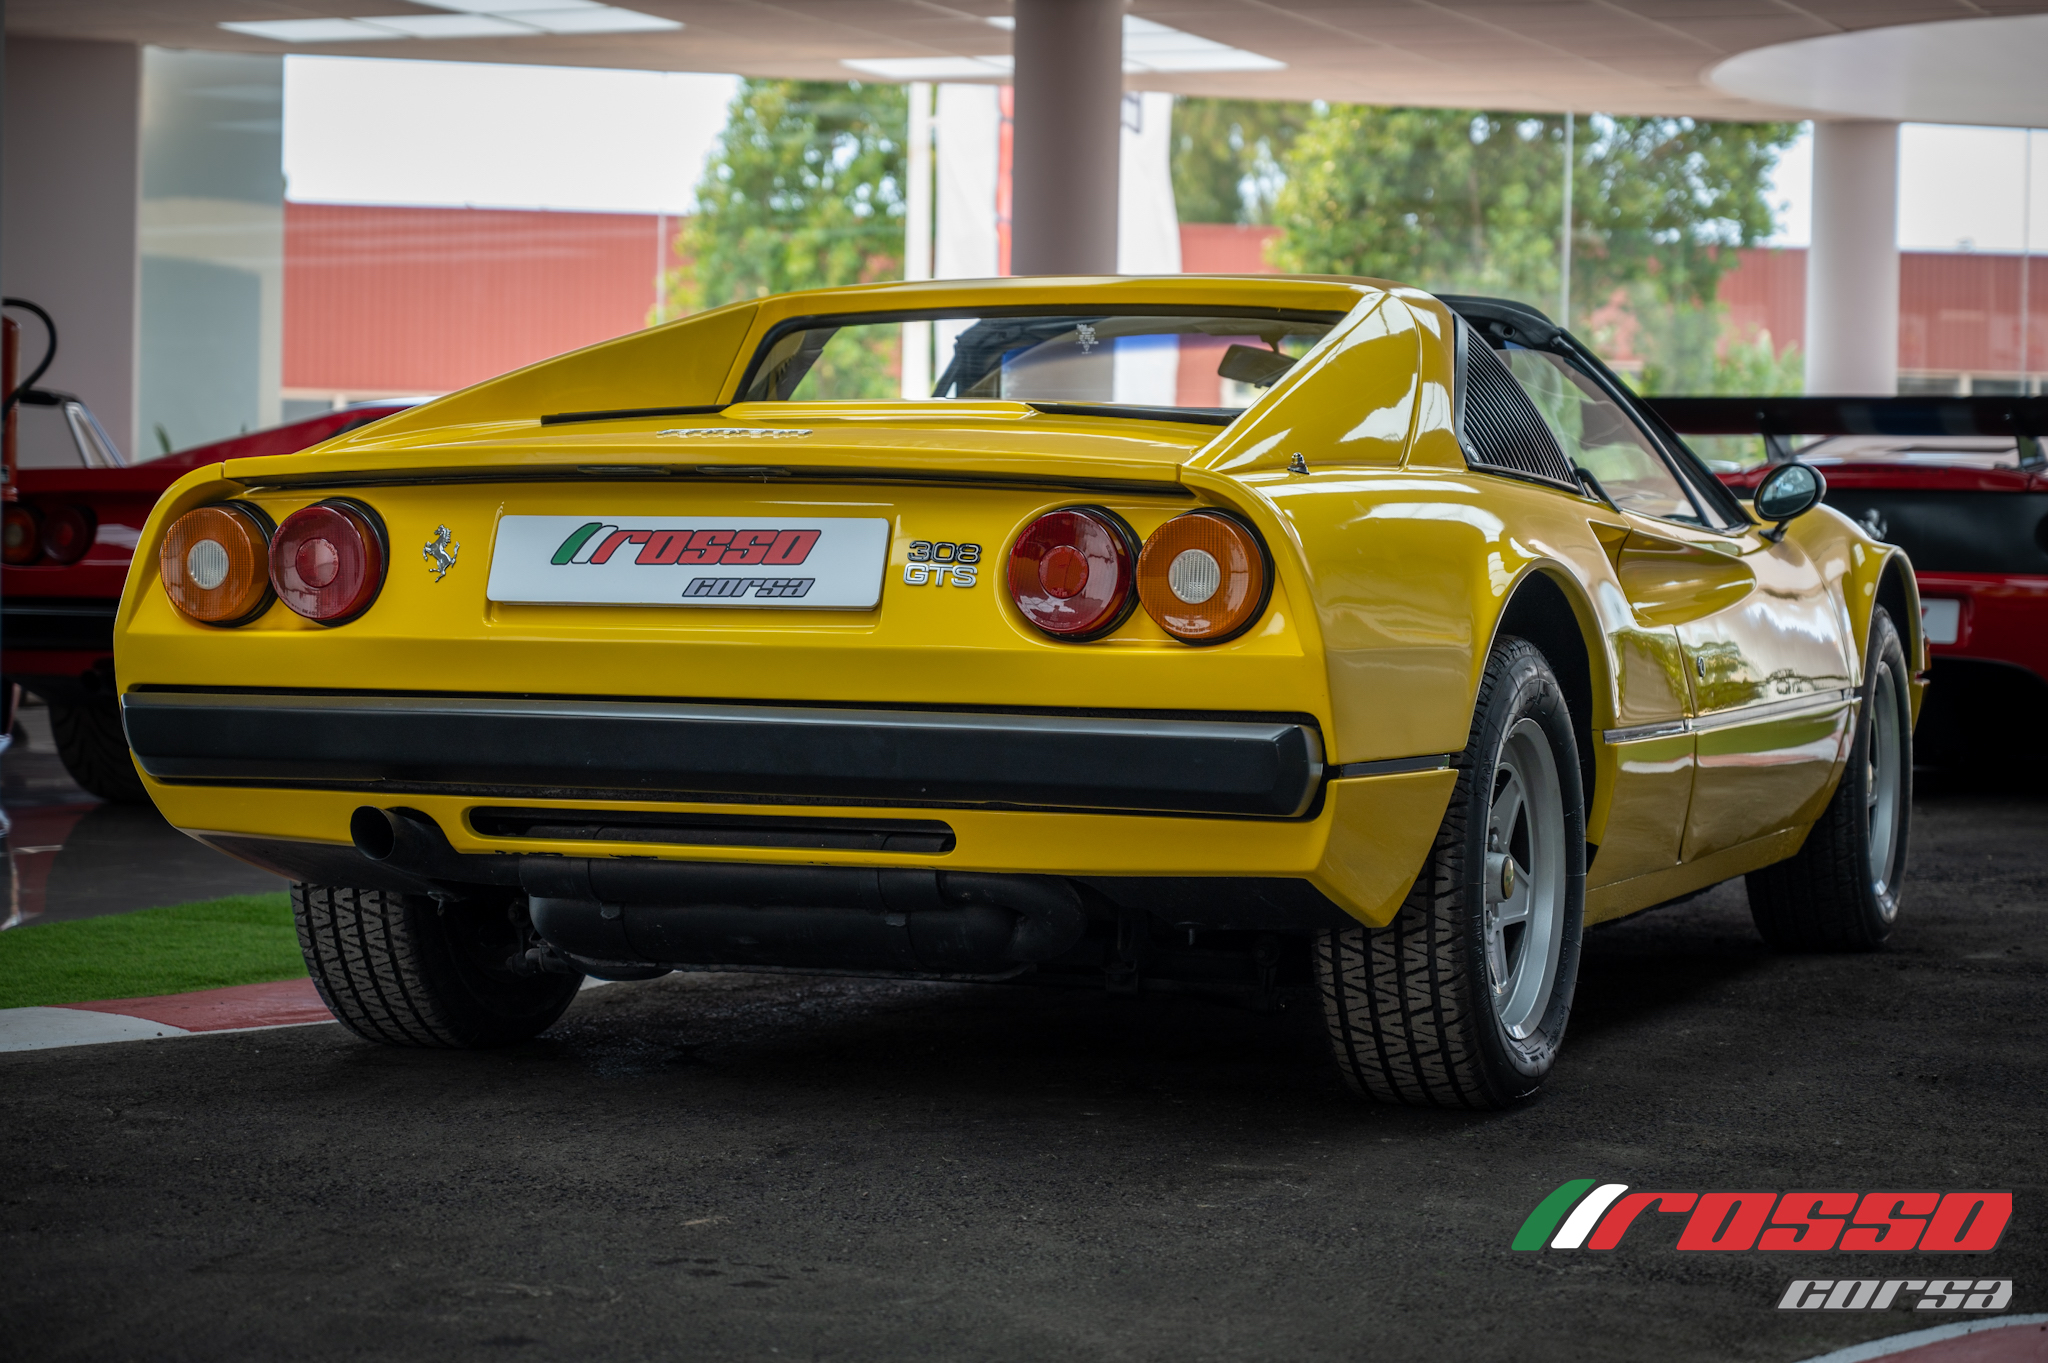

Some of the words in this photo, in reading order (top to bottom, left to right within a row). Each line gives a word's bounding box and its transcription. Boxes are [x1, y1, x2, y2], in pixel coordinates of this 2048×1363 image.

[590, 529, 822, 565] rosso
[907, 540, 982, 564] 308
[682, 577, 816, 598] corsa
[903, 562, 978, 588] GTS
